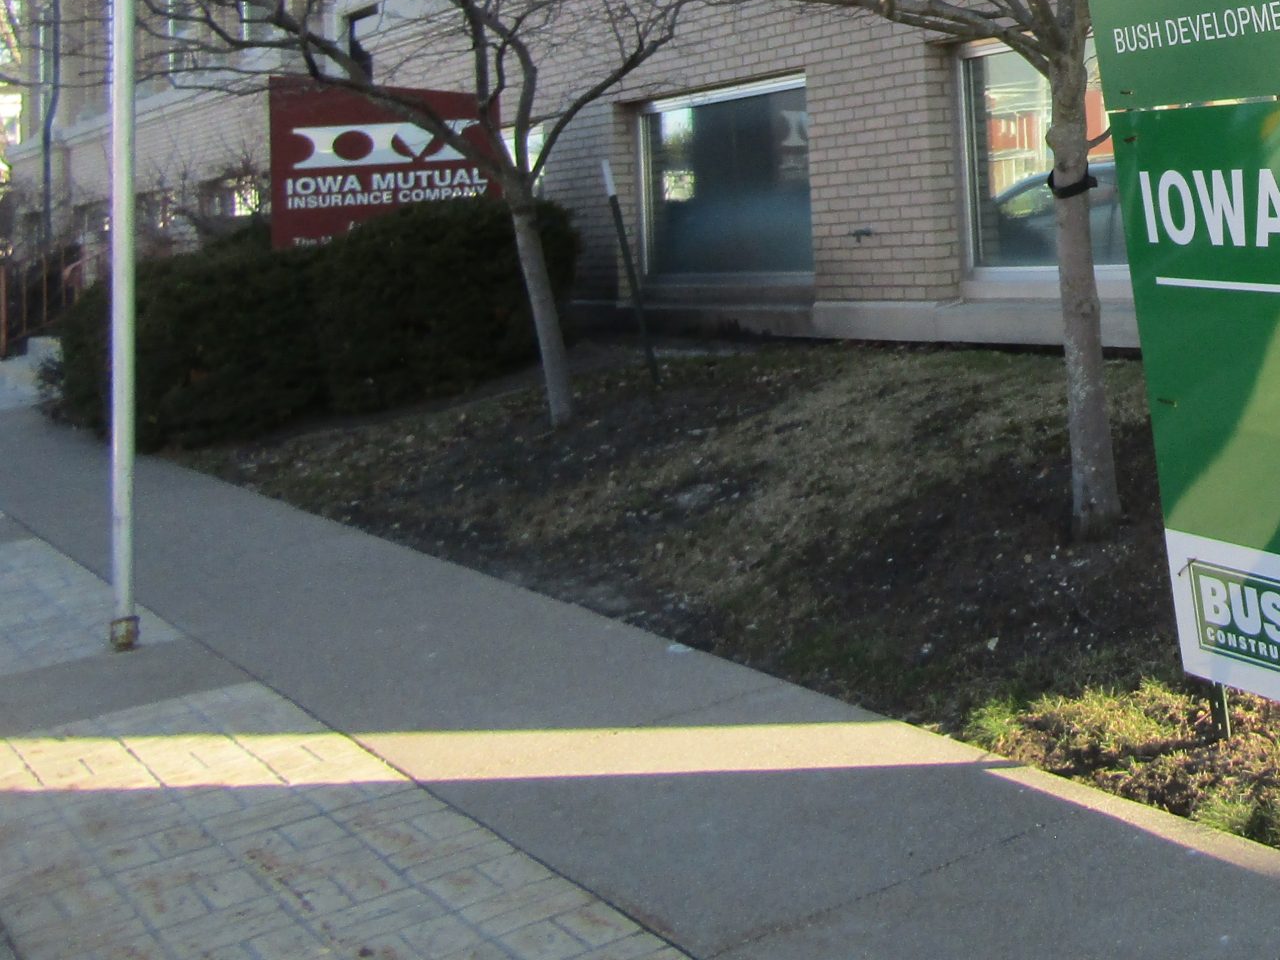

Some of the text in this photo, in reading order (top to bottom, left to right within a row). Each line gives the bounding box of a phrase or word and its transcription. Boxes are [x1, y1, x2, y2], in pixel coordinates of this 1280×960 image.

[1113, 21, 1162, 54] BUSH
[285, 167, 488, 195] IOWA MUTUAL
[287, 191, 393, 209] INSURANCE
